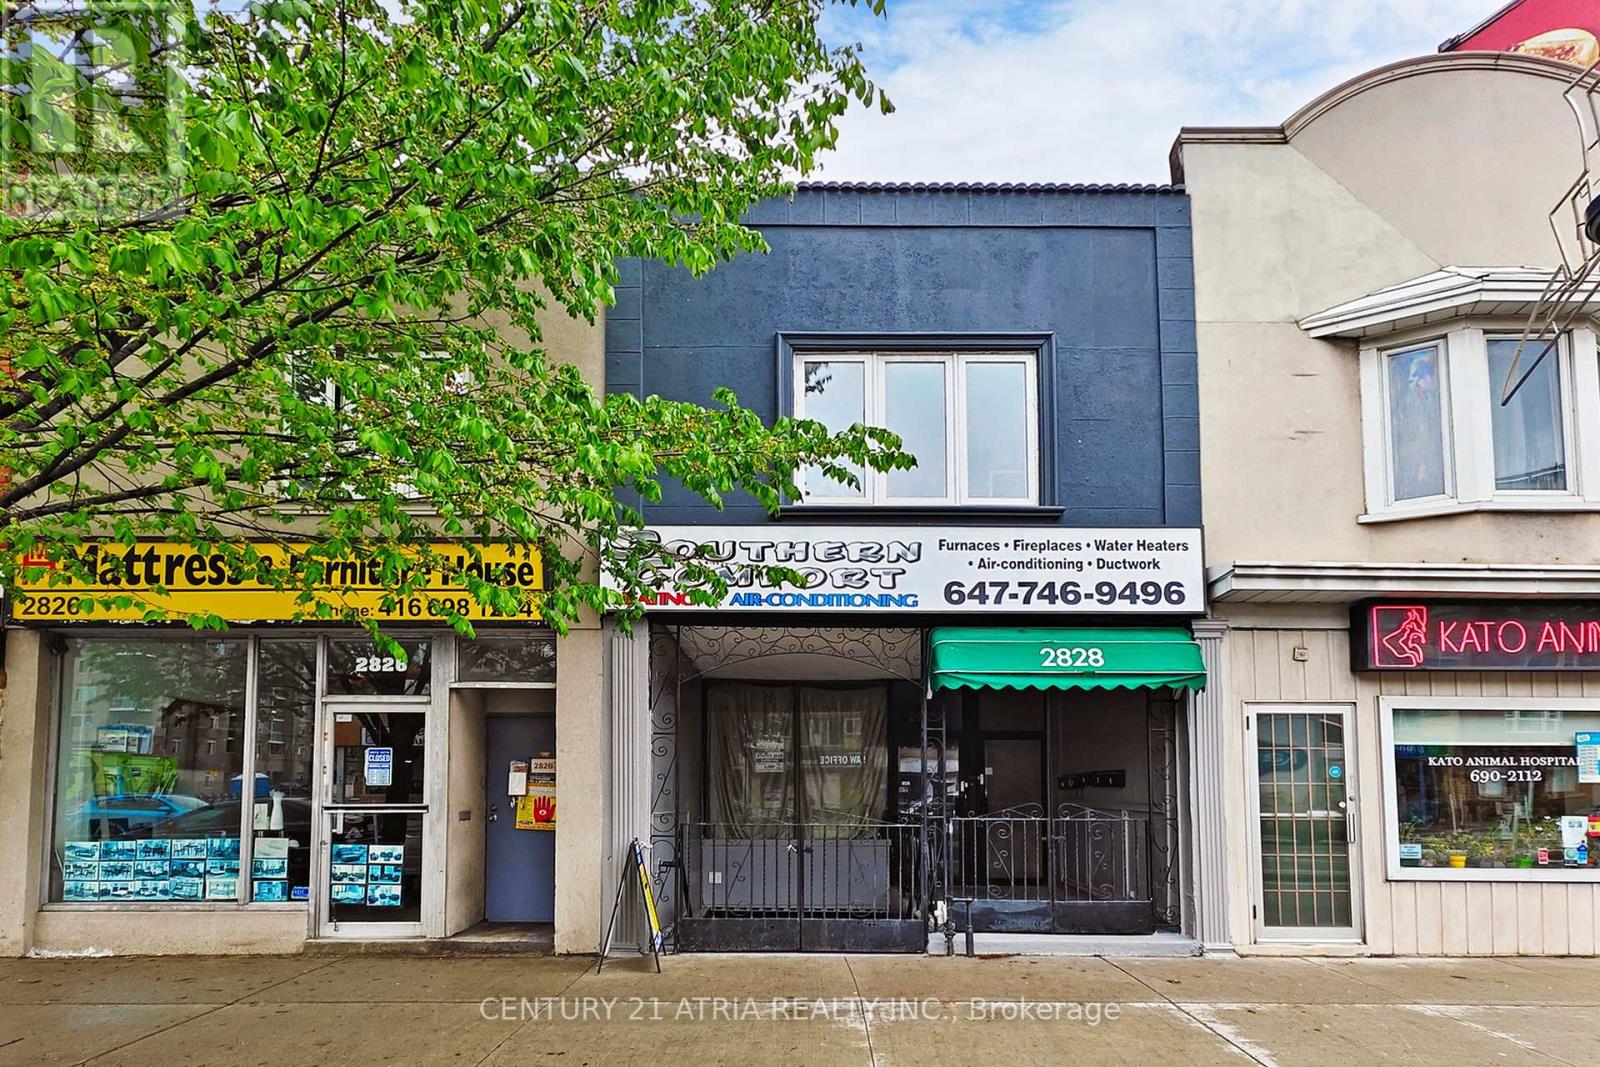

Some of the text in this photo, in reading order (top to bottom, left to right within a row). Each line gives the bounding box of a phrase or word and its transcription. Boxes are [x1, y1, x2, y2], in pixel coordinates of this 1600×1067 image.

[609, 530, 922, 563] SOUTHERN
[939, 539, 1189, 553] Furnaces Fireplaces Water Heaters
[442, 555, 534, 587] House
[977, 558, 1161, 572] Air-conditioning Ductwork
[729, 592, 919, 607] AIR-CONDITIONING
[943, 581, 1186, 605] 647-746-9496
[22, 597, 80, 615] 2826
[1440, 620, 1527, 653] KATO
[355, 656, 408, 672] 2826
[1040, 647, 1105, 667] 2828
[1428, 756, 1585, 767] KATO ANIMAL HOSPITAL
[1470, 770, 1543, 783] 690-2112
